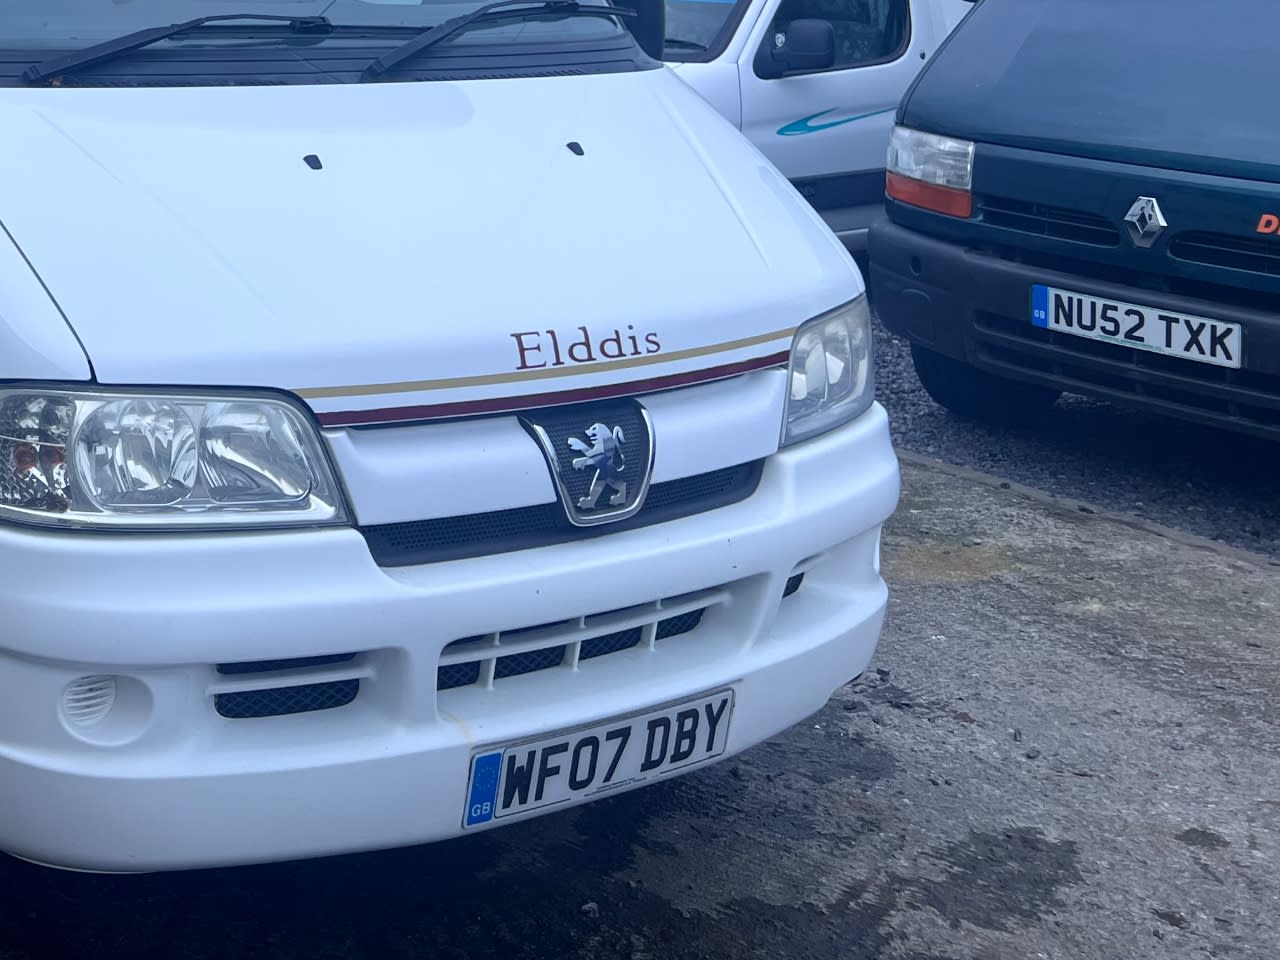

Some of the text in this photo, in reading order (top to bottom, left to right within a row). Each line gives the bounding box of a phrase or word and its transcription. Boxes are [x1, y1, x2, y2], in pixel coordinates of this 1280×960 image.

[1256, 213, 1280, 235] D
[510, 324, 661, 370] Elddis
[1053, 293, 1233, 361] NU52 TXK
[502, 698, 729, 810] WF07 DBY
[472, 801, 491, 817] GB
